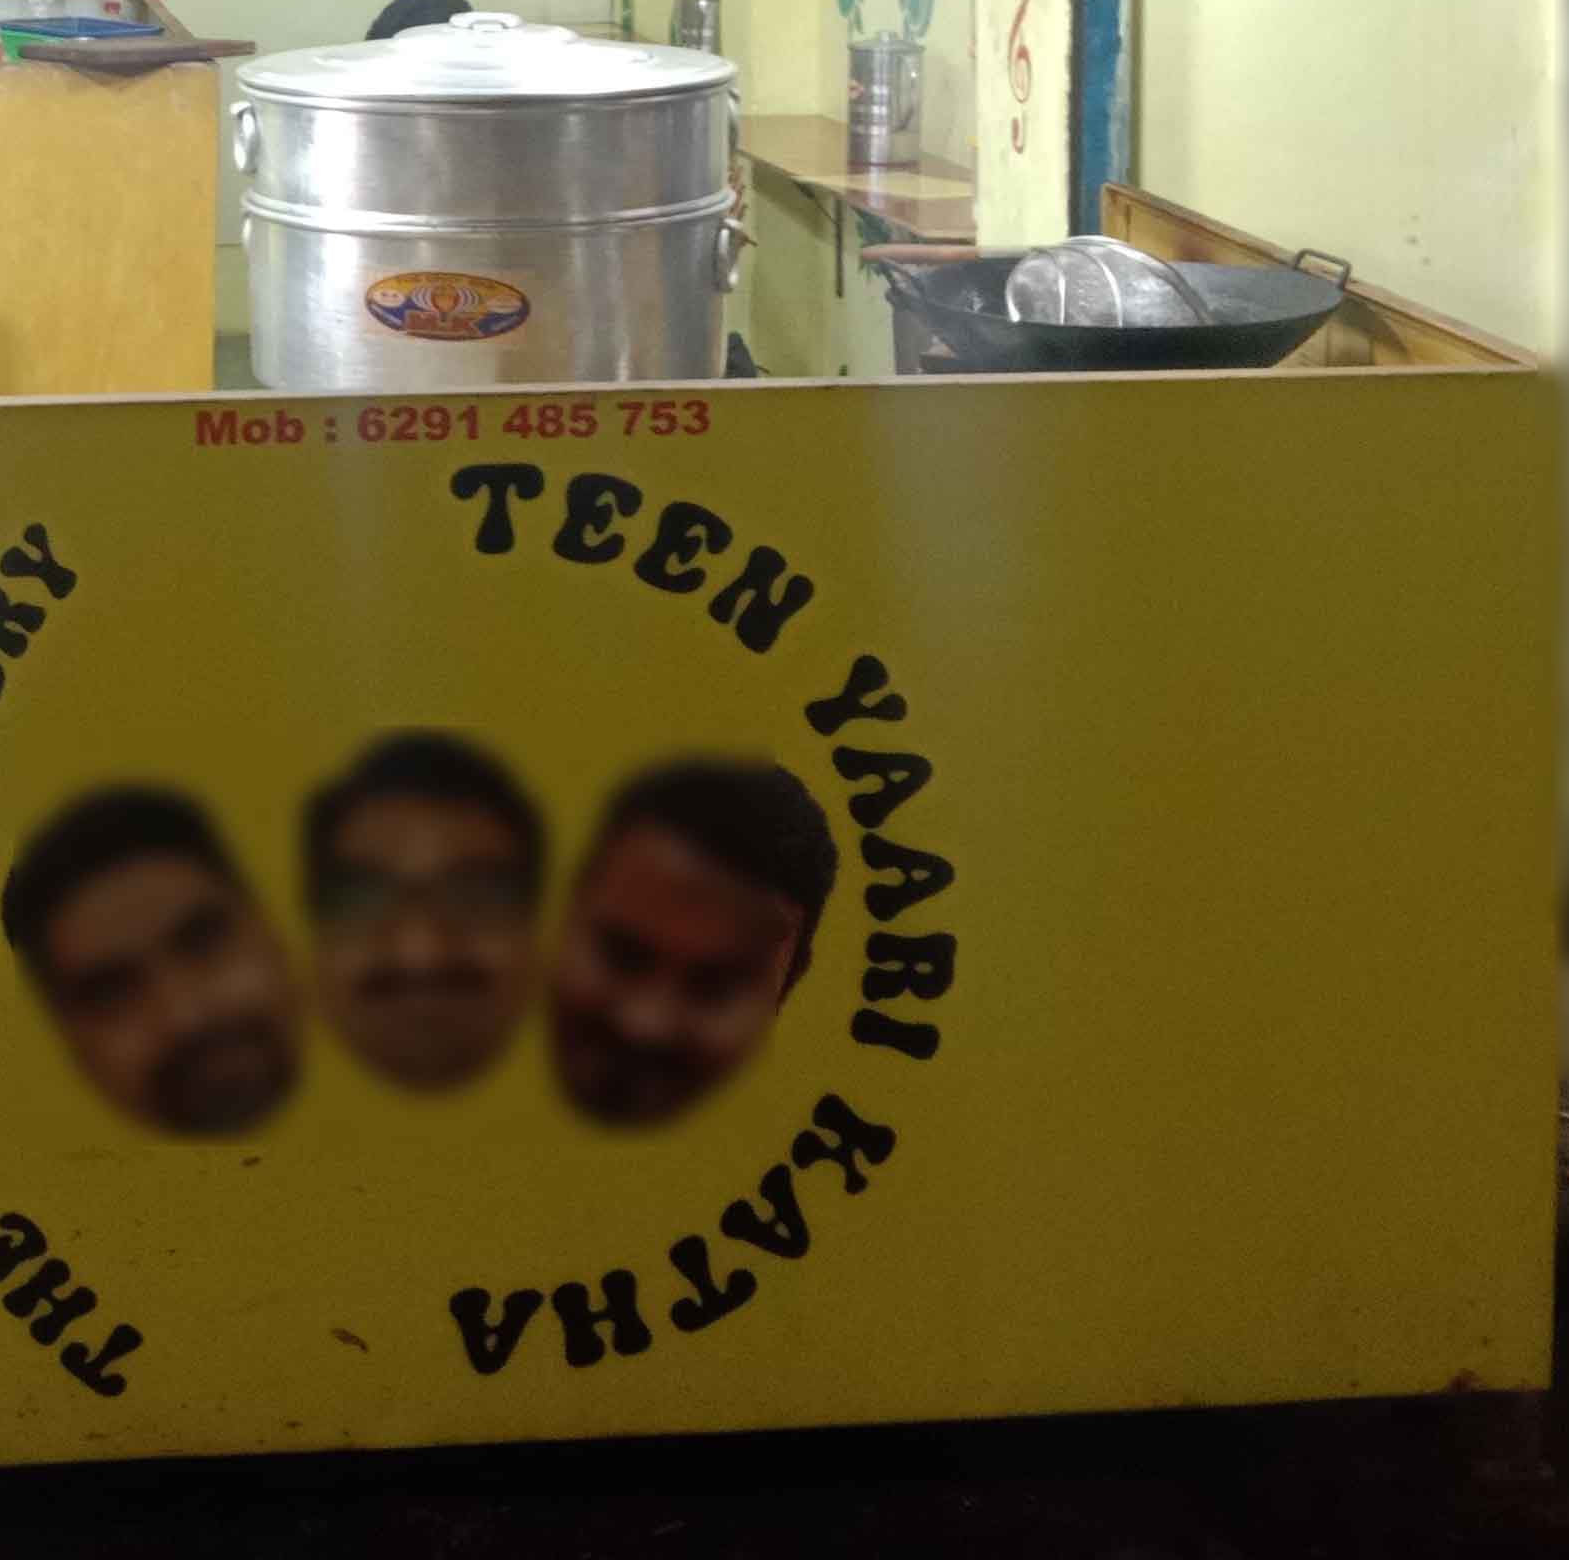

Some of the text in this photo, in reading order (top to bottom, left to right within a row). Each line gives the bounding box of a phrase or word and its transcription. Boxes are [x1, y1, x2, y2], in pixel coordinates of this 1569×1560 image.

[195, 408, 304, 446] Mob
[358, 405, 480, 442] 6291
[502, 402, 598, 439] 485
[616, 400, 710, 436] 753
[449, 462, 956, 1375] TEEN YAARI KATHA
